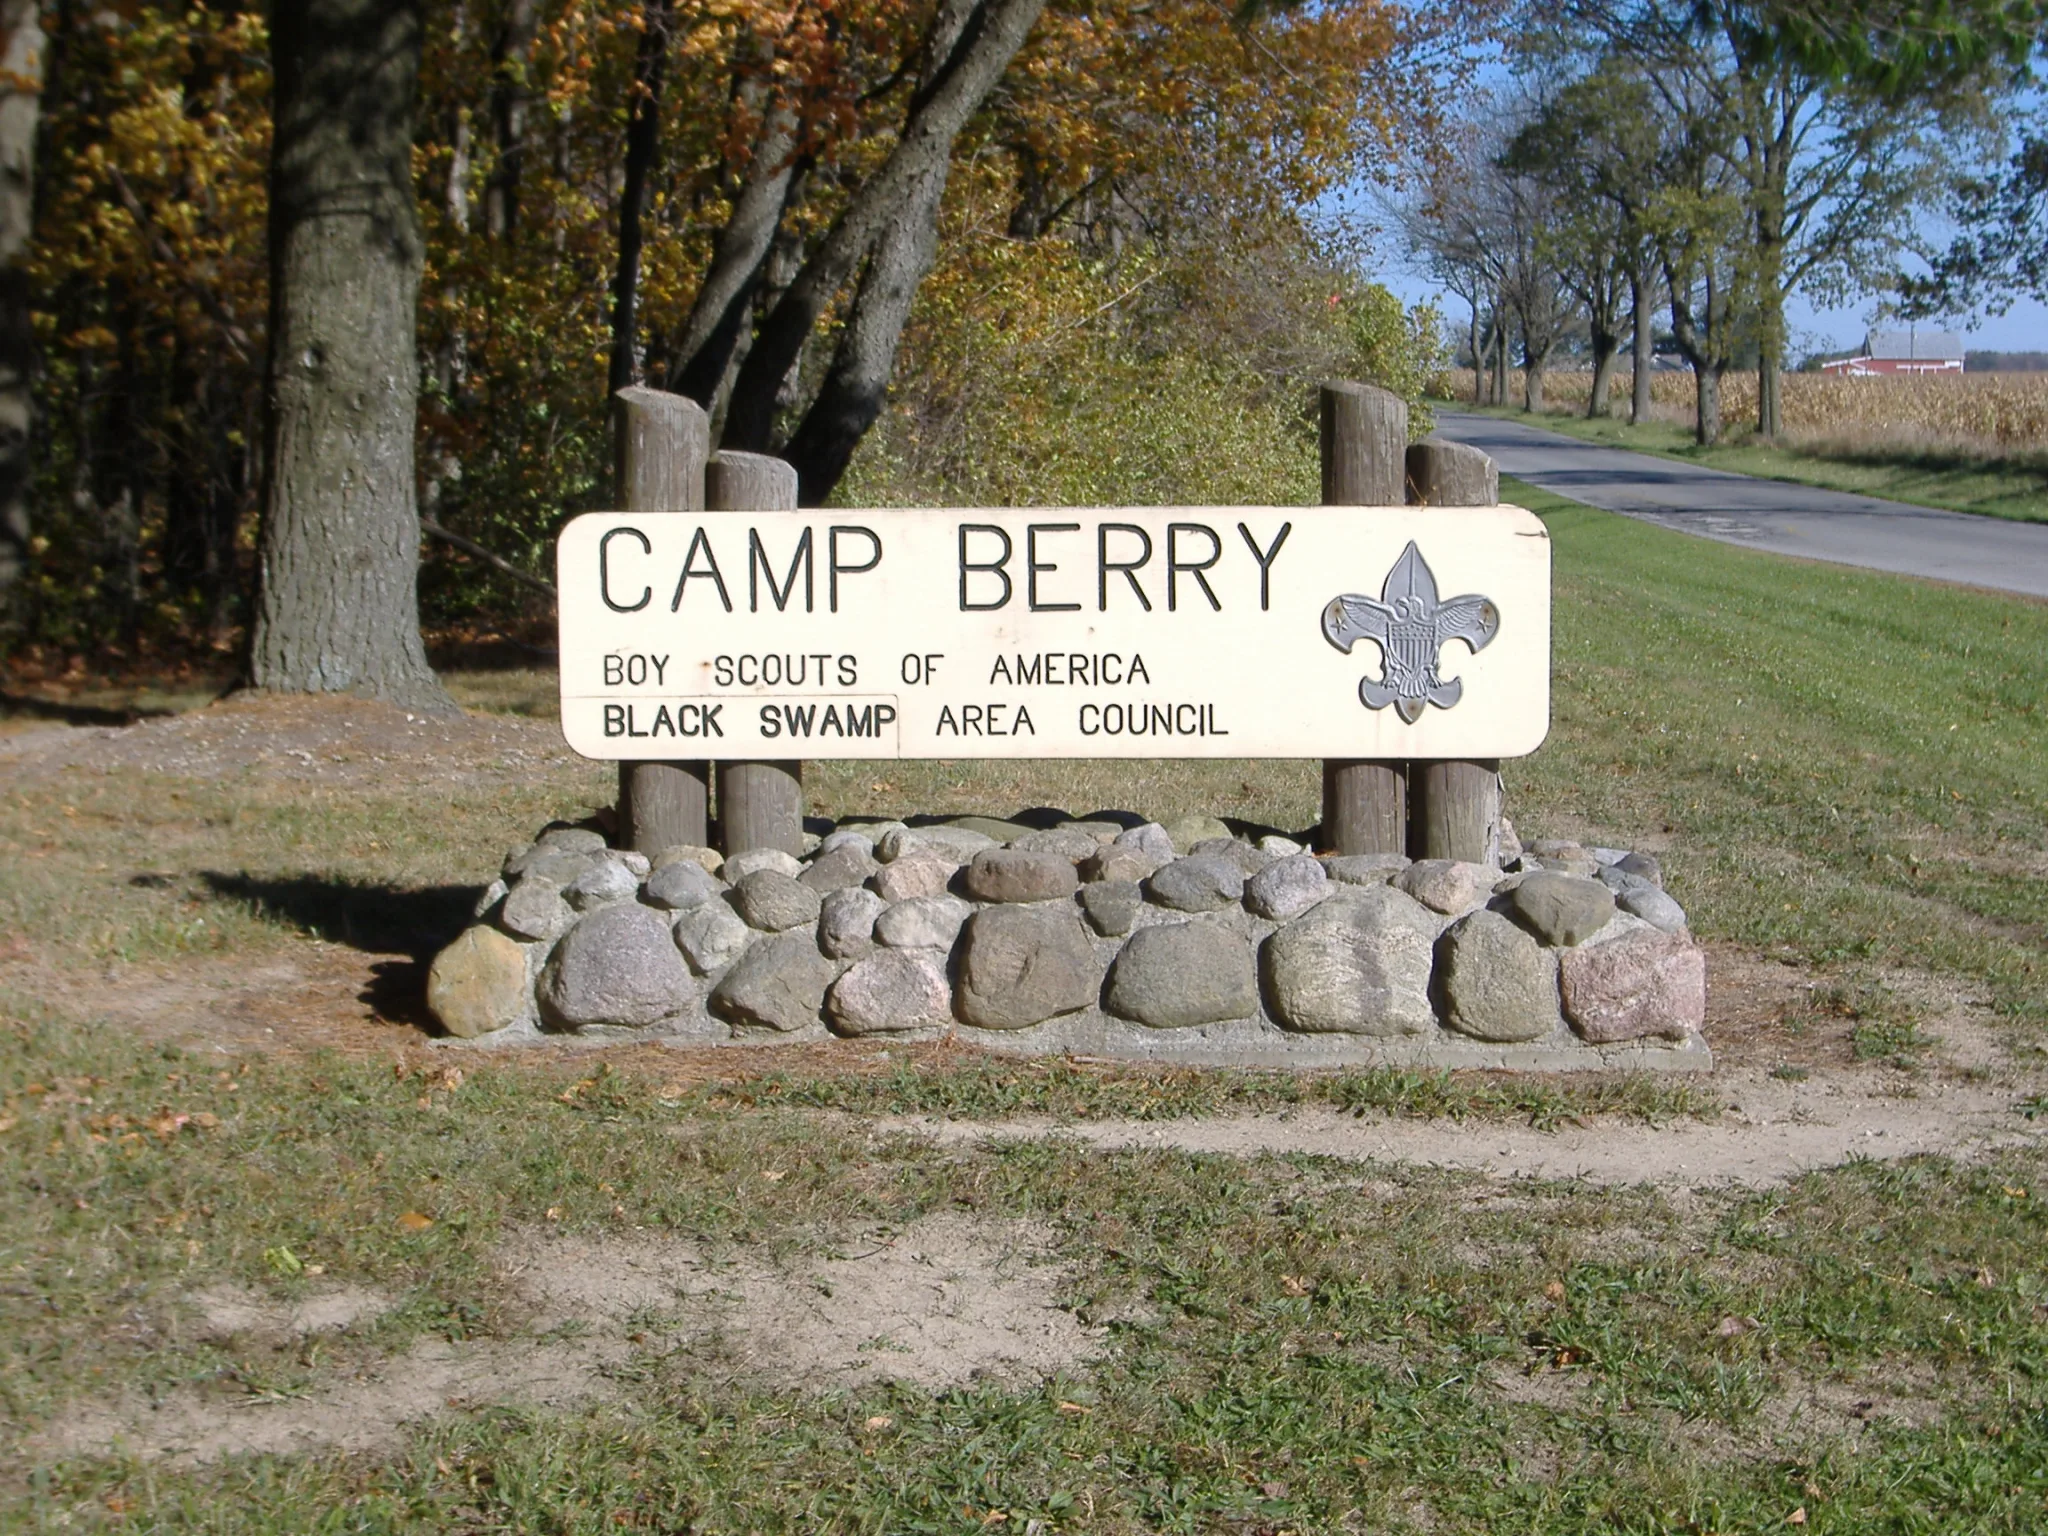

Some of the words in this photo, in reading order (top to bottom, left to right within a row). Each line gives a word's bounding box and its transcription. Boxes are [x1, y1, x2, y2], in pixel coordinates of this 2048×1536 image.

[600, 525, 883, 613] CAMP
[959, 522, 1292, 612] BERRY
[604, 654, 670, 686] BOY
[715, 654, 857, 686] SCOUTS
[902, 653, 945, 685] OF
[990, 653, 1150, 686] AMERICA
[603, 704, 724, 738] BLACK
[760, 704, 897, 738] SWAMP
[936, 704, 1036, 736] AREA
[1080, 703, 1229, 736] COUNCIL
